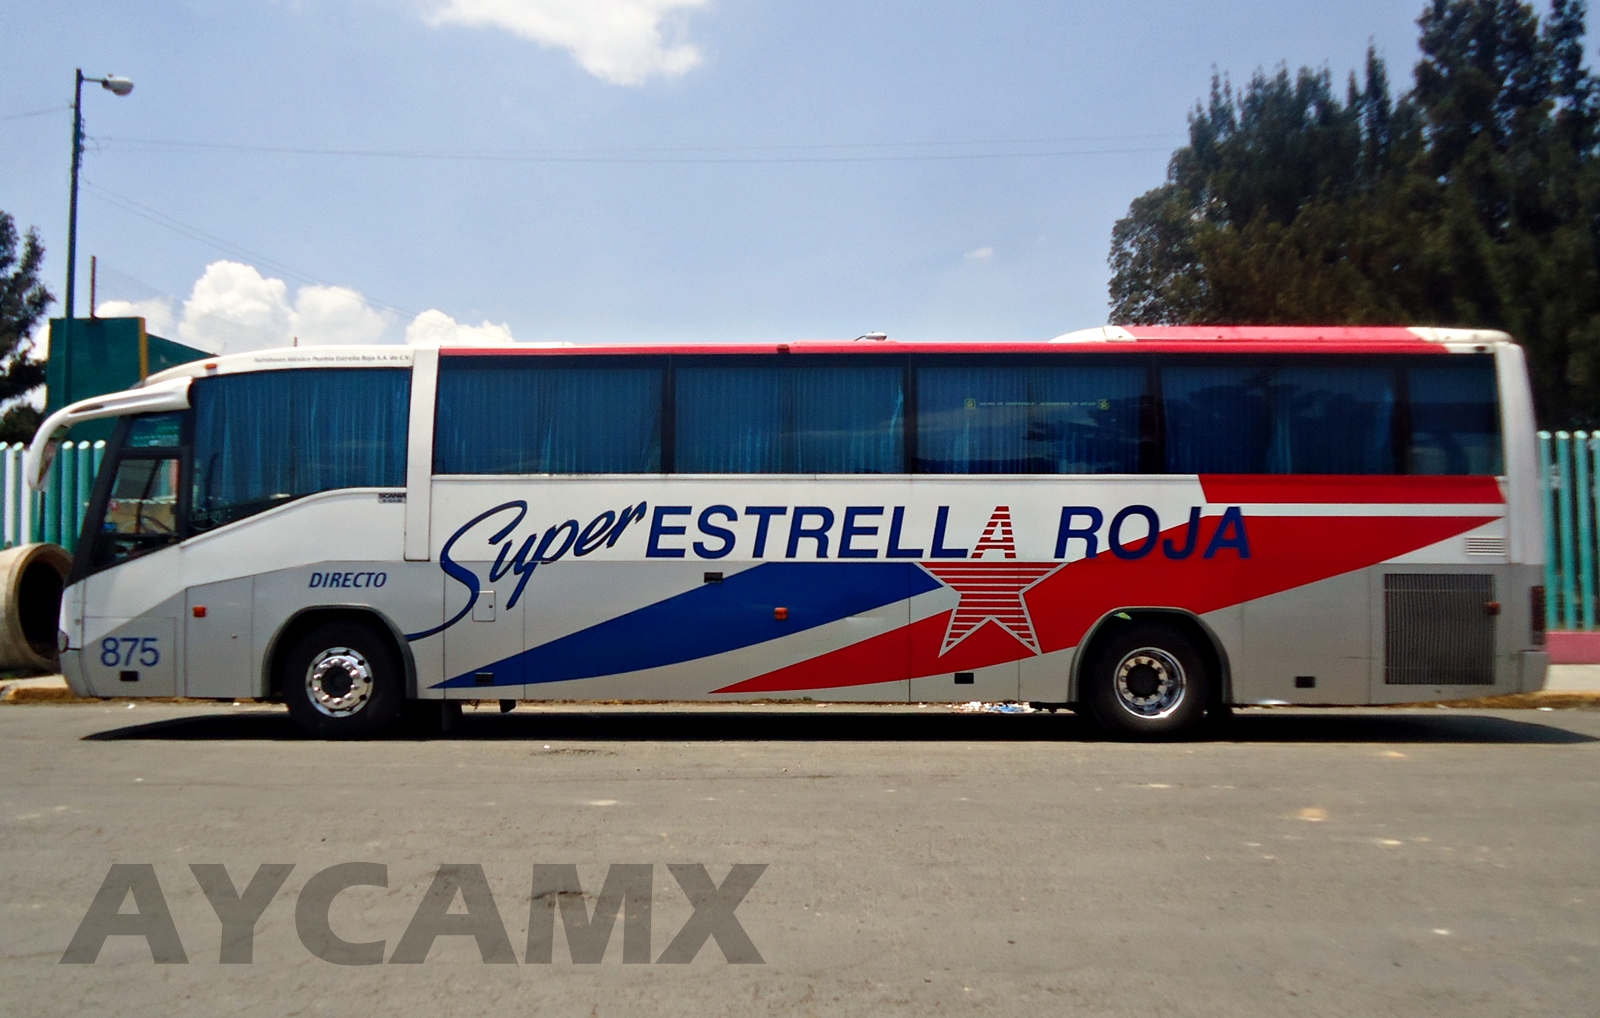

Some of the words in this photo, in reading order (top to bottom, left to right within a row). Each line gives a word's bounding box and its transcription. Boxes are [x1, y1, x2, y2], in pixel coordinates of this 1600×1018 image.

[361, 355, 376, 363] Roja
[308, 572, 388, 588] DIRECTO
[406, 500, 647, 642] Super
[646, 505, 1017, 560] ESTRELLA
[1054, 504, 1252, 560] ROJA
[100, 636, 161, 667] 875
